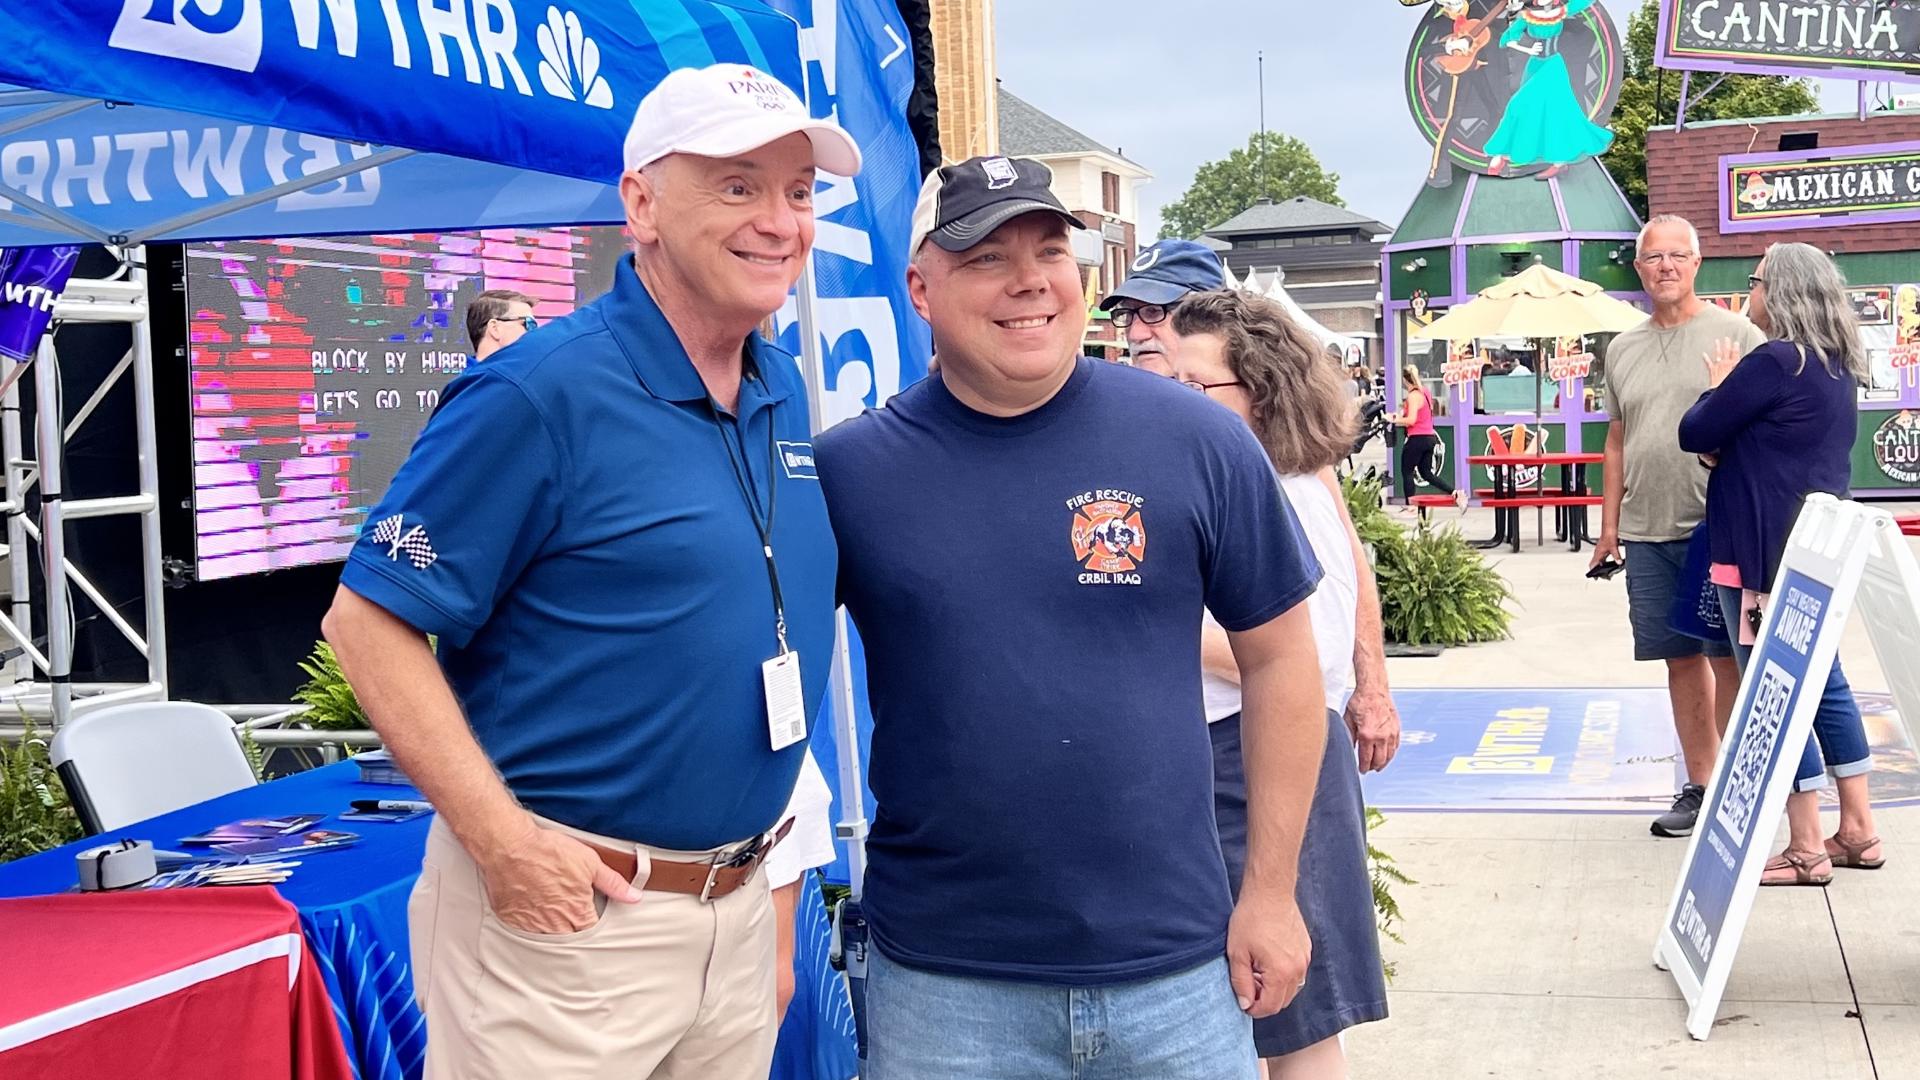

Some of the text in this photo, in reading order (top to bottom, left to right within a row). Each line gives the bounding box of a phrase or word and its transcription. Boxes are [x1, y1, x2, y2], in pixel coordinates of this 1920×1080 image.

[1691, 0, 1899, 51] CANTINA
[1771, 168, 1895, 203] MEXICAN
[384, 351, 407, 374] BY
[1551, 364, 1589, 379] CORN
[1444, 368, 1480, 384] CORN
[375, 389, 401, 409] GO
[1065, 491, 1095, 511] FIRE
[1095, 489, 1145, 508] RESCUE
[1077, 573, 1142, 585] ERBIL IRAQ
[1774, 604, 1817, 656] AWARE
[1472, 719, 1549, 757] WTHR
